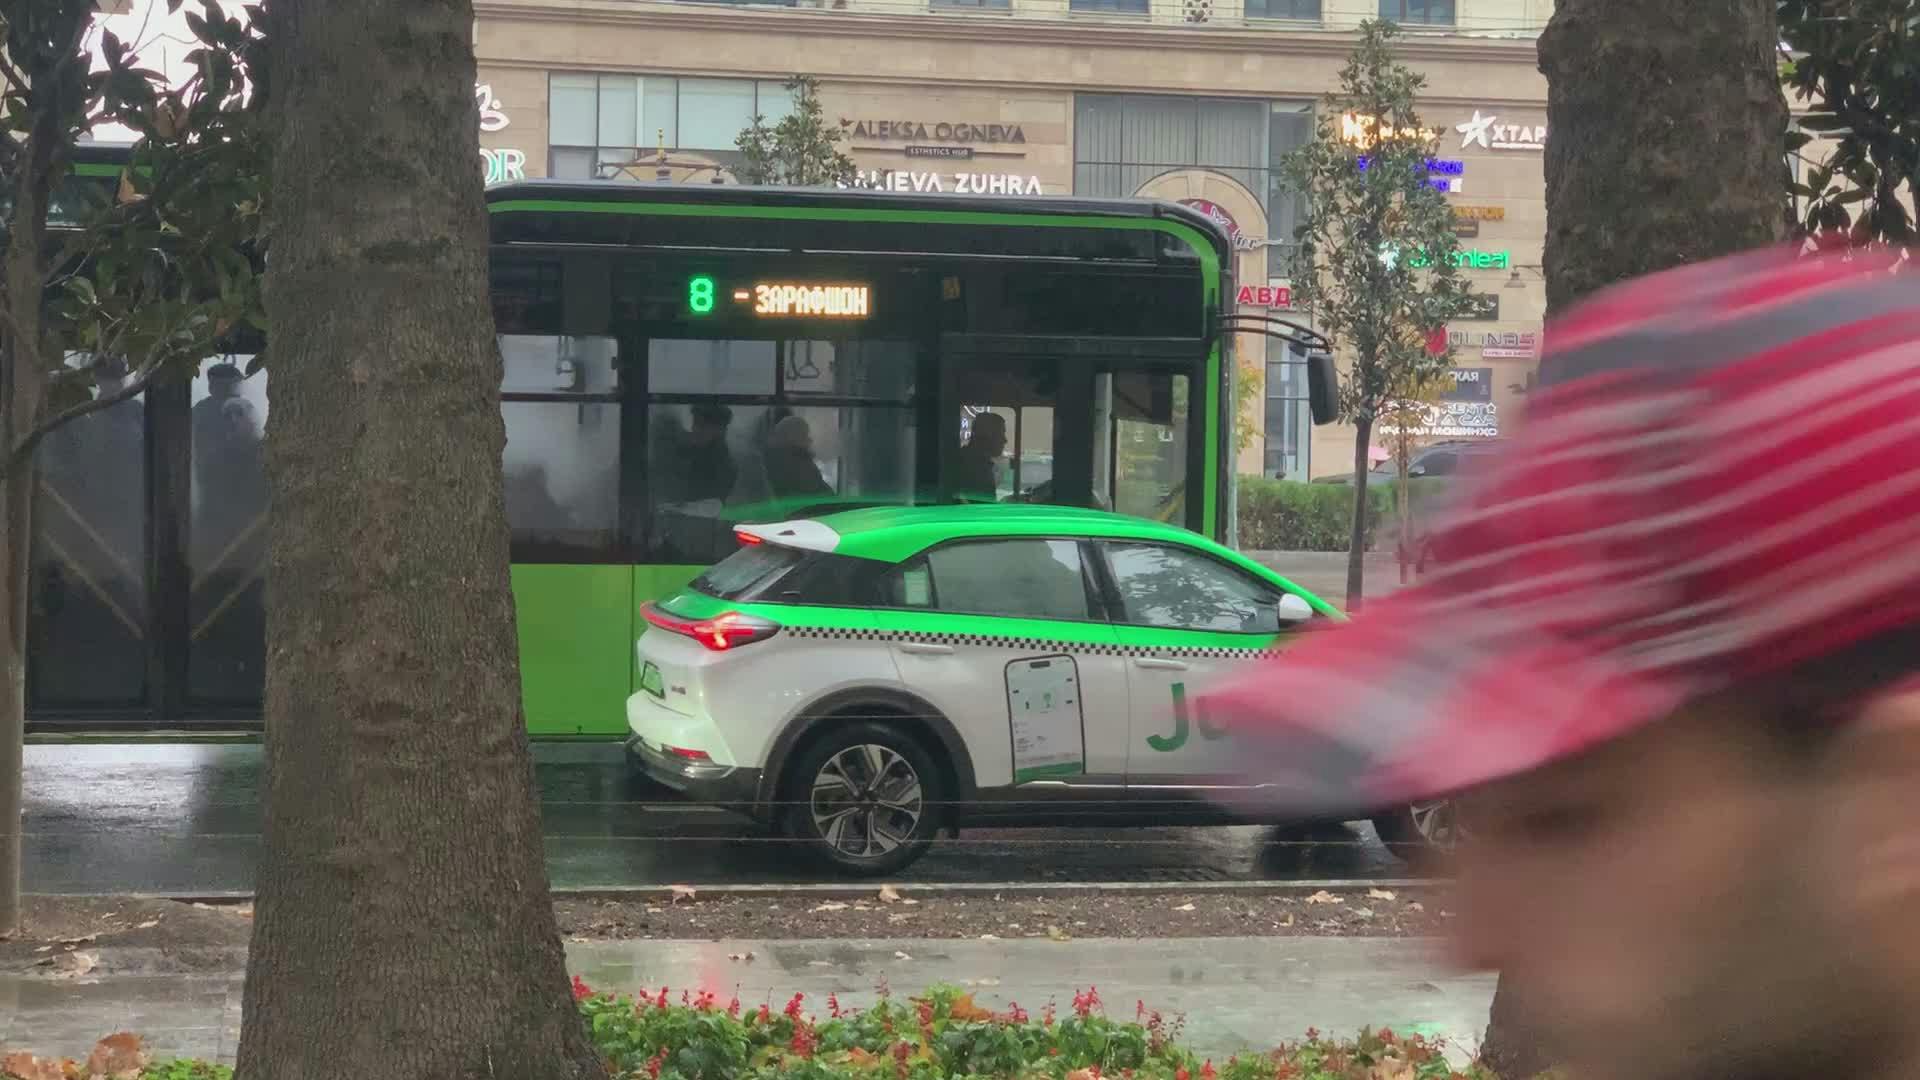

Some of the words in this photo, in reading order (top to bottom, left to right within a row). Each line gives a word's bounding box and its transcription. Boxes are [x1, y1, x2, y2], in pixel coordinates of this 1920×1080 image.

[853, 120, 929, 141] ALEKSA
[935, 122, 1026, 143] OGNEVA
[909, 148, 950, 156] ESTHETICS
[954, 173, 1042, 195] ZUHRA
[689, 277, 713, 312] 8
[755, 284, 868, 315] ЗАРАФШОН
